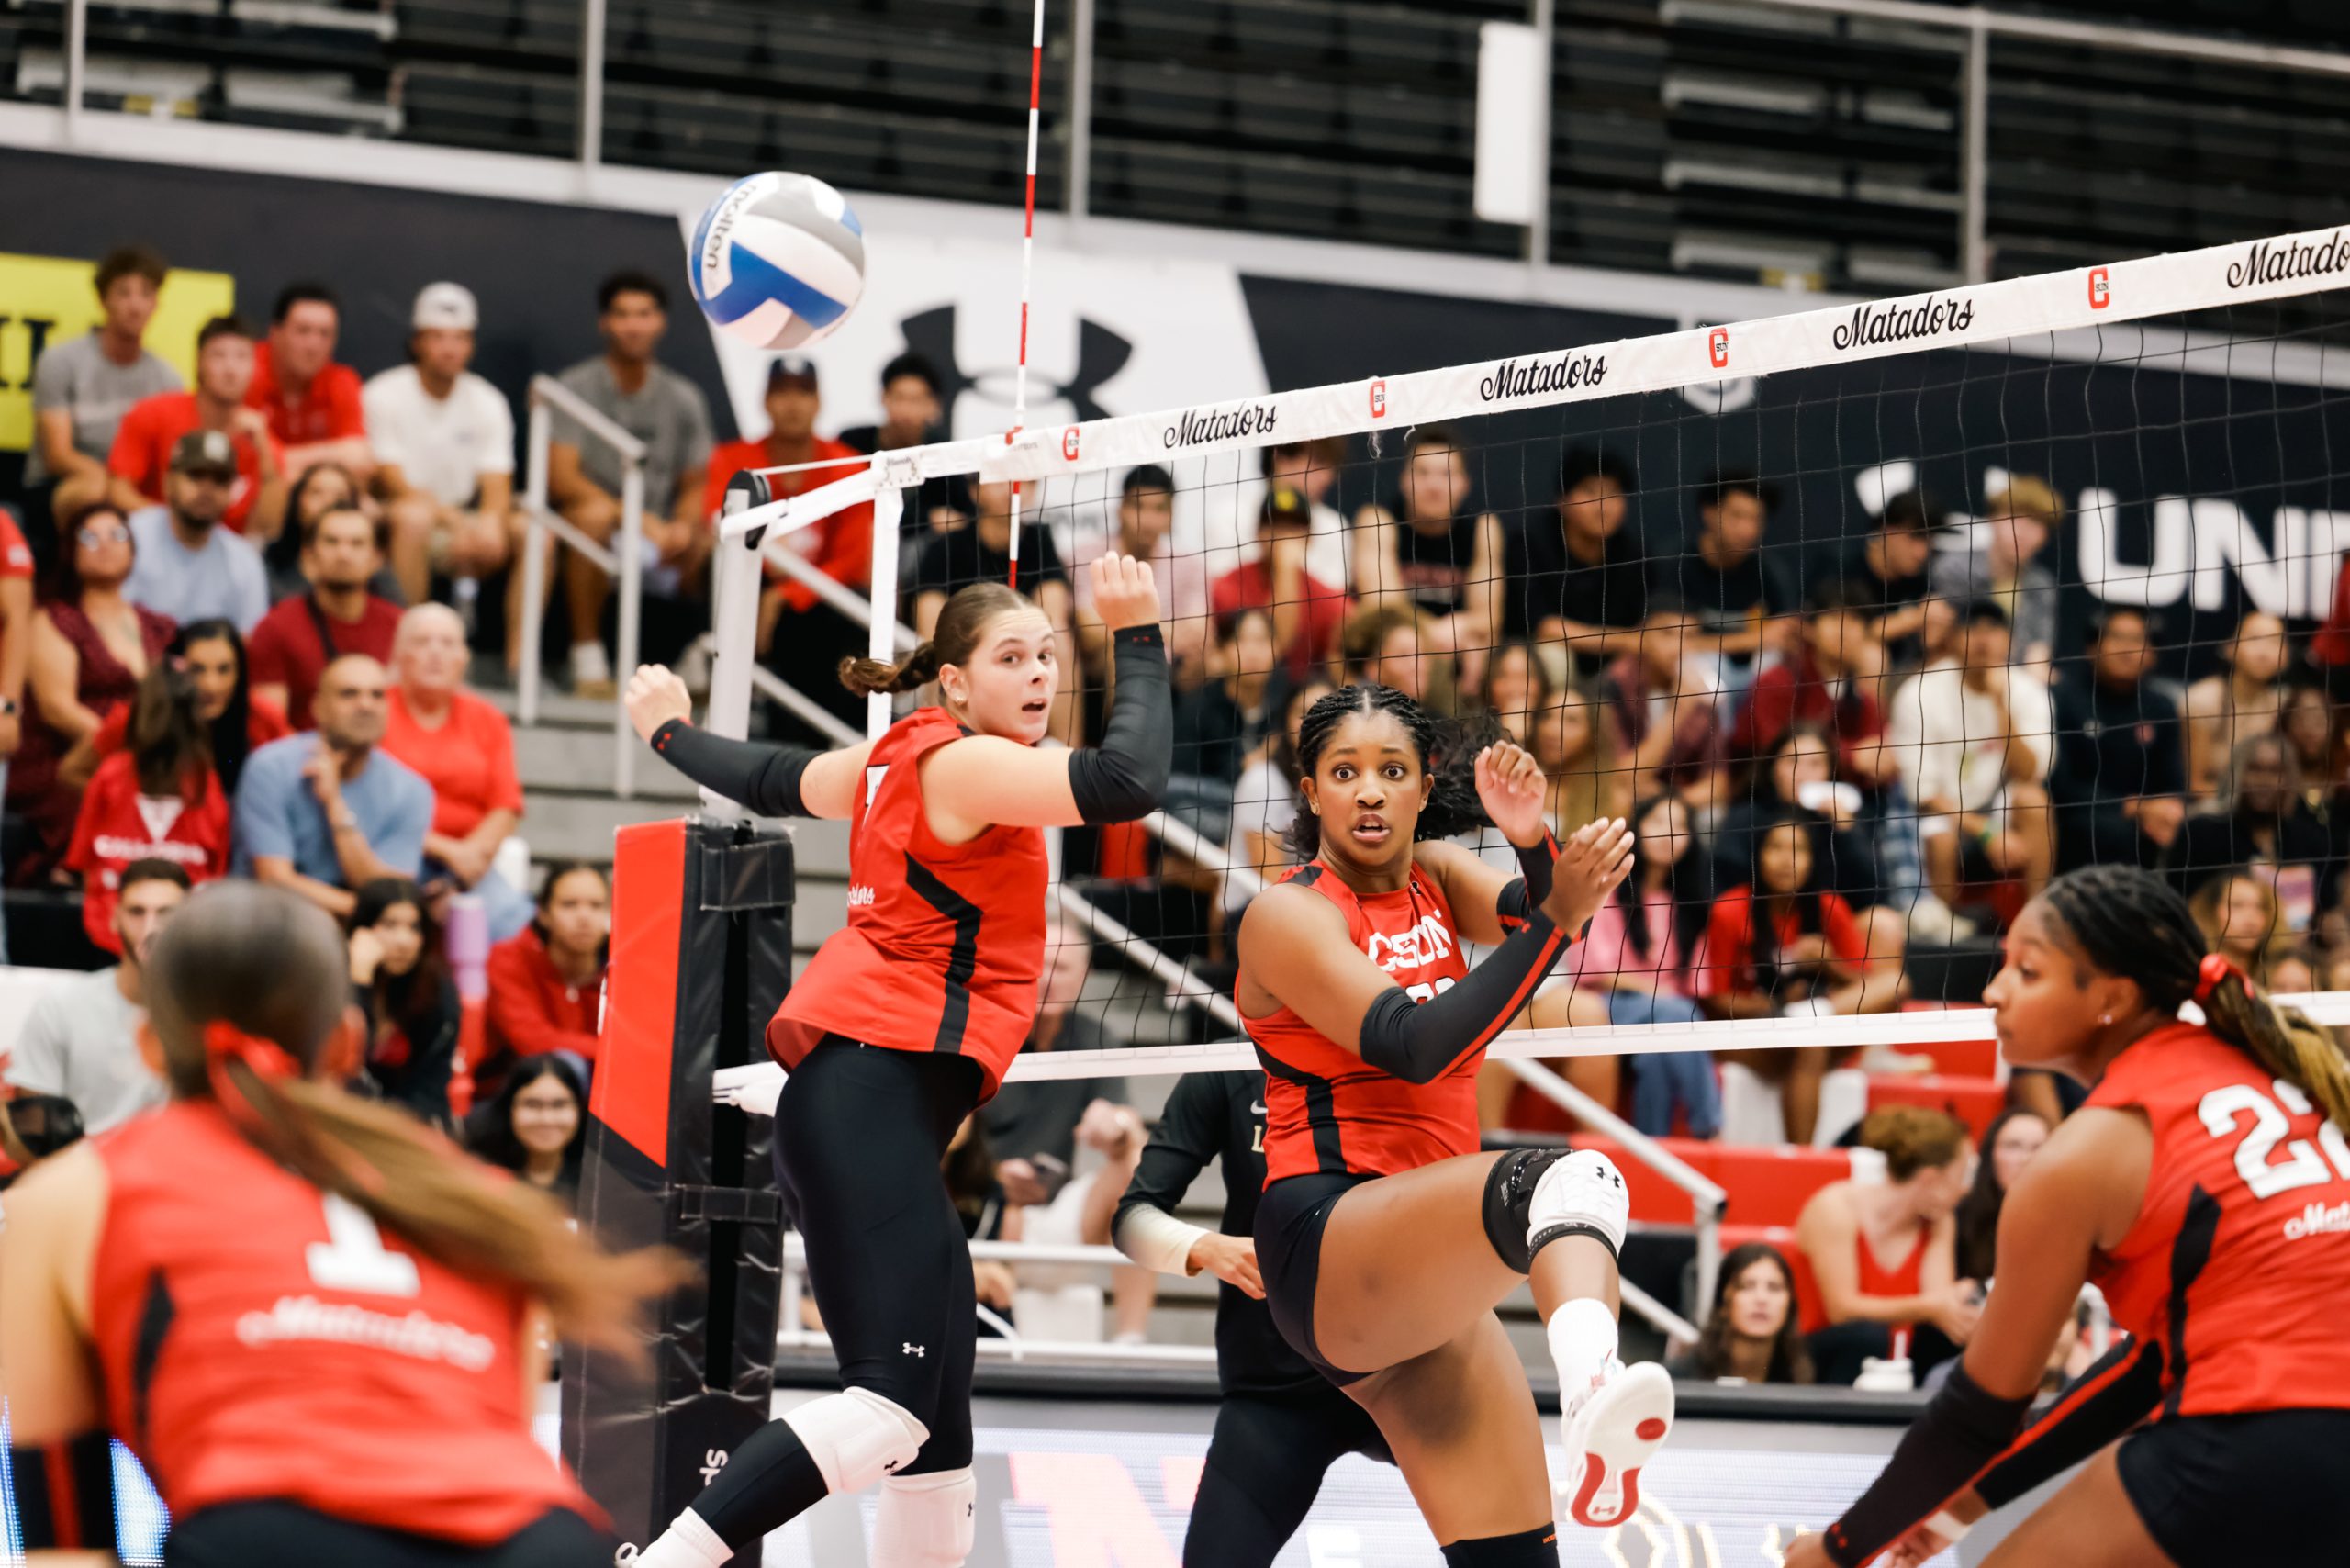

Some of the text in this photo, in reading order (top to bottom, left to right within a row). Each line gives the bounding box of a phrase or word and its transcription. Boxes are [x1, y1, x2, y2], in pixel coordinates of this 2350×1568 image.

[706, 184, 756, 269] molten
[2227, 230, 2350, 288] Matado
[1833, 295, 1975, 351] Matadors
[1480, 351, 1608, 401] Matadors
[1164, 400, 1278, 449] Matadors
[1368, 909, 1453, 972] CSUN
[306, 1192, 421, 1296] 1
